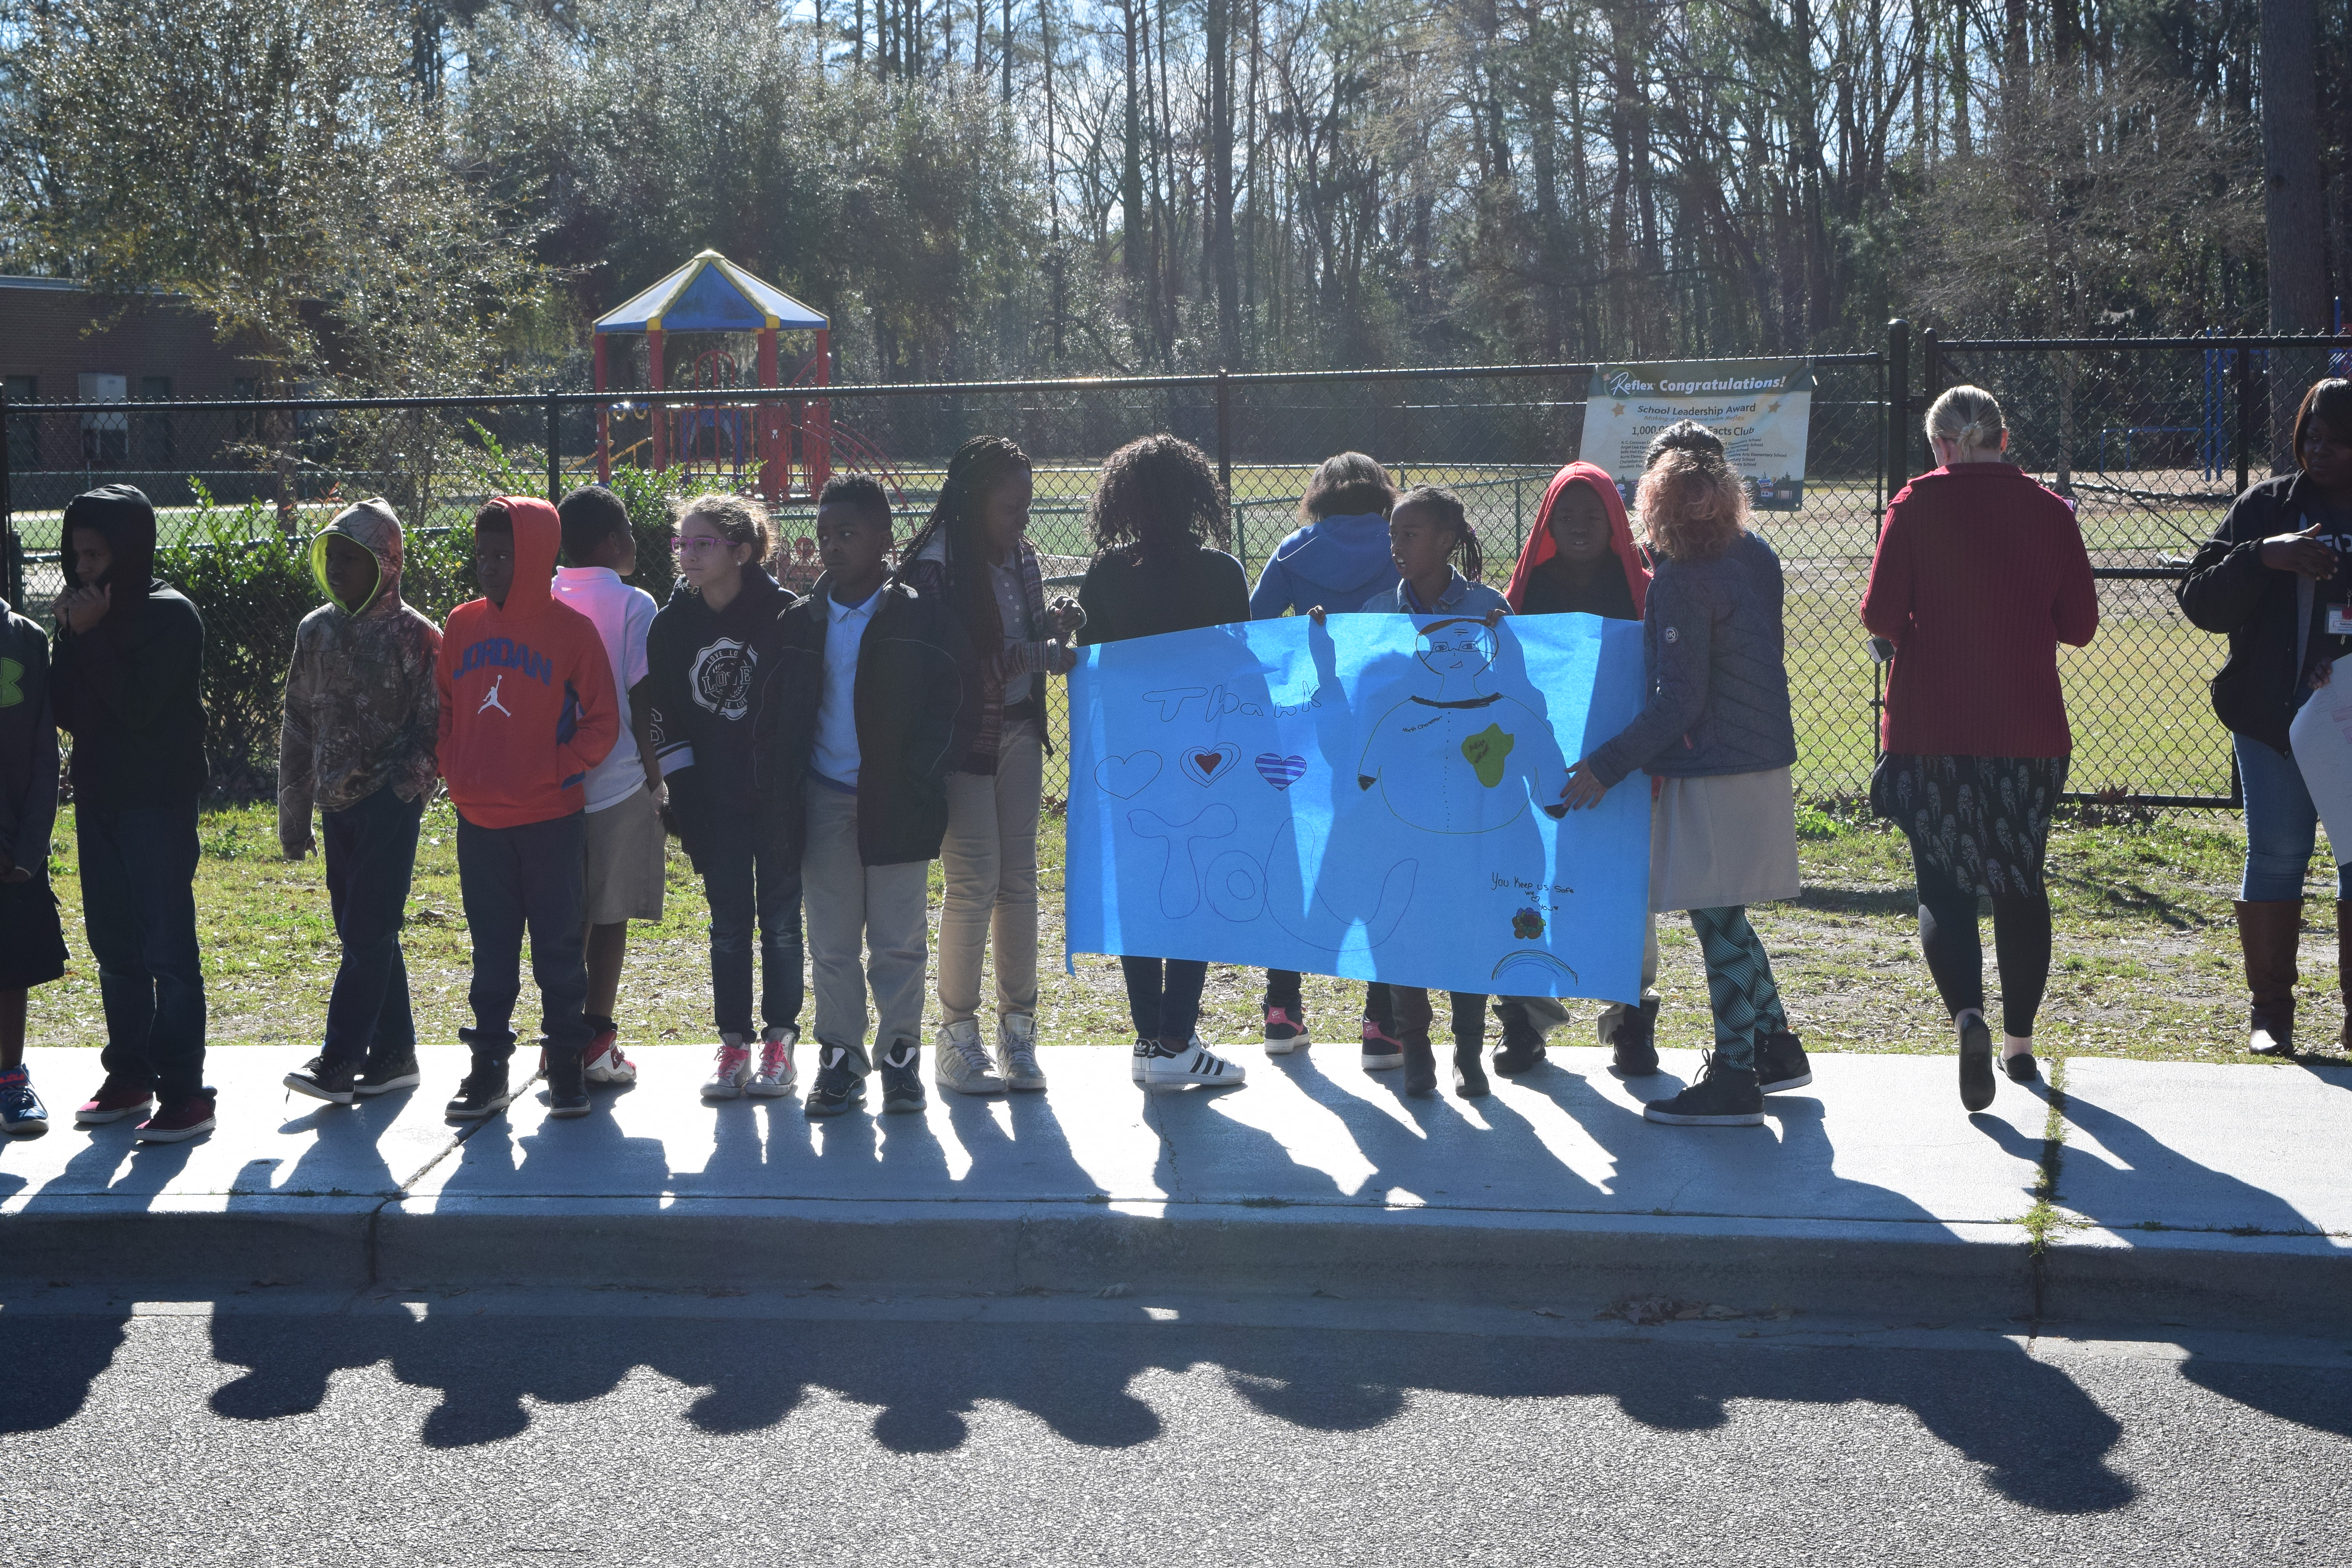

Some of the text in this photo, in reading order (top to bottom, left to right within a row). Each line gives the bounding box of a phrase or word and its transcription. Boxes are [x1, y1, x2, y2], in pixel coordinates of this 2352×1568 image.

[1610, 371, 1787, 396] Reflex Congratulations!
[1637, 403, 1756, 416] School Leadership Award
[1734, 427, 1754, 436] Club
[453, 638, 553, 686] JORDAN
[706, 651, 723, 664] LOVE
[1491, 872, 1509, 890] You
